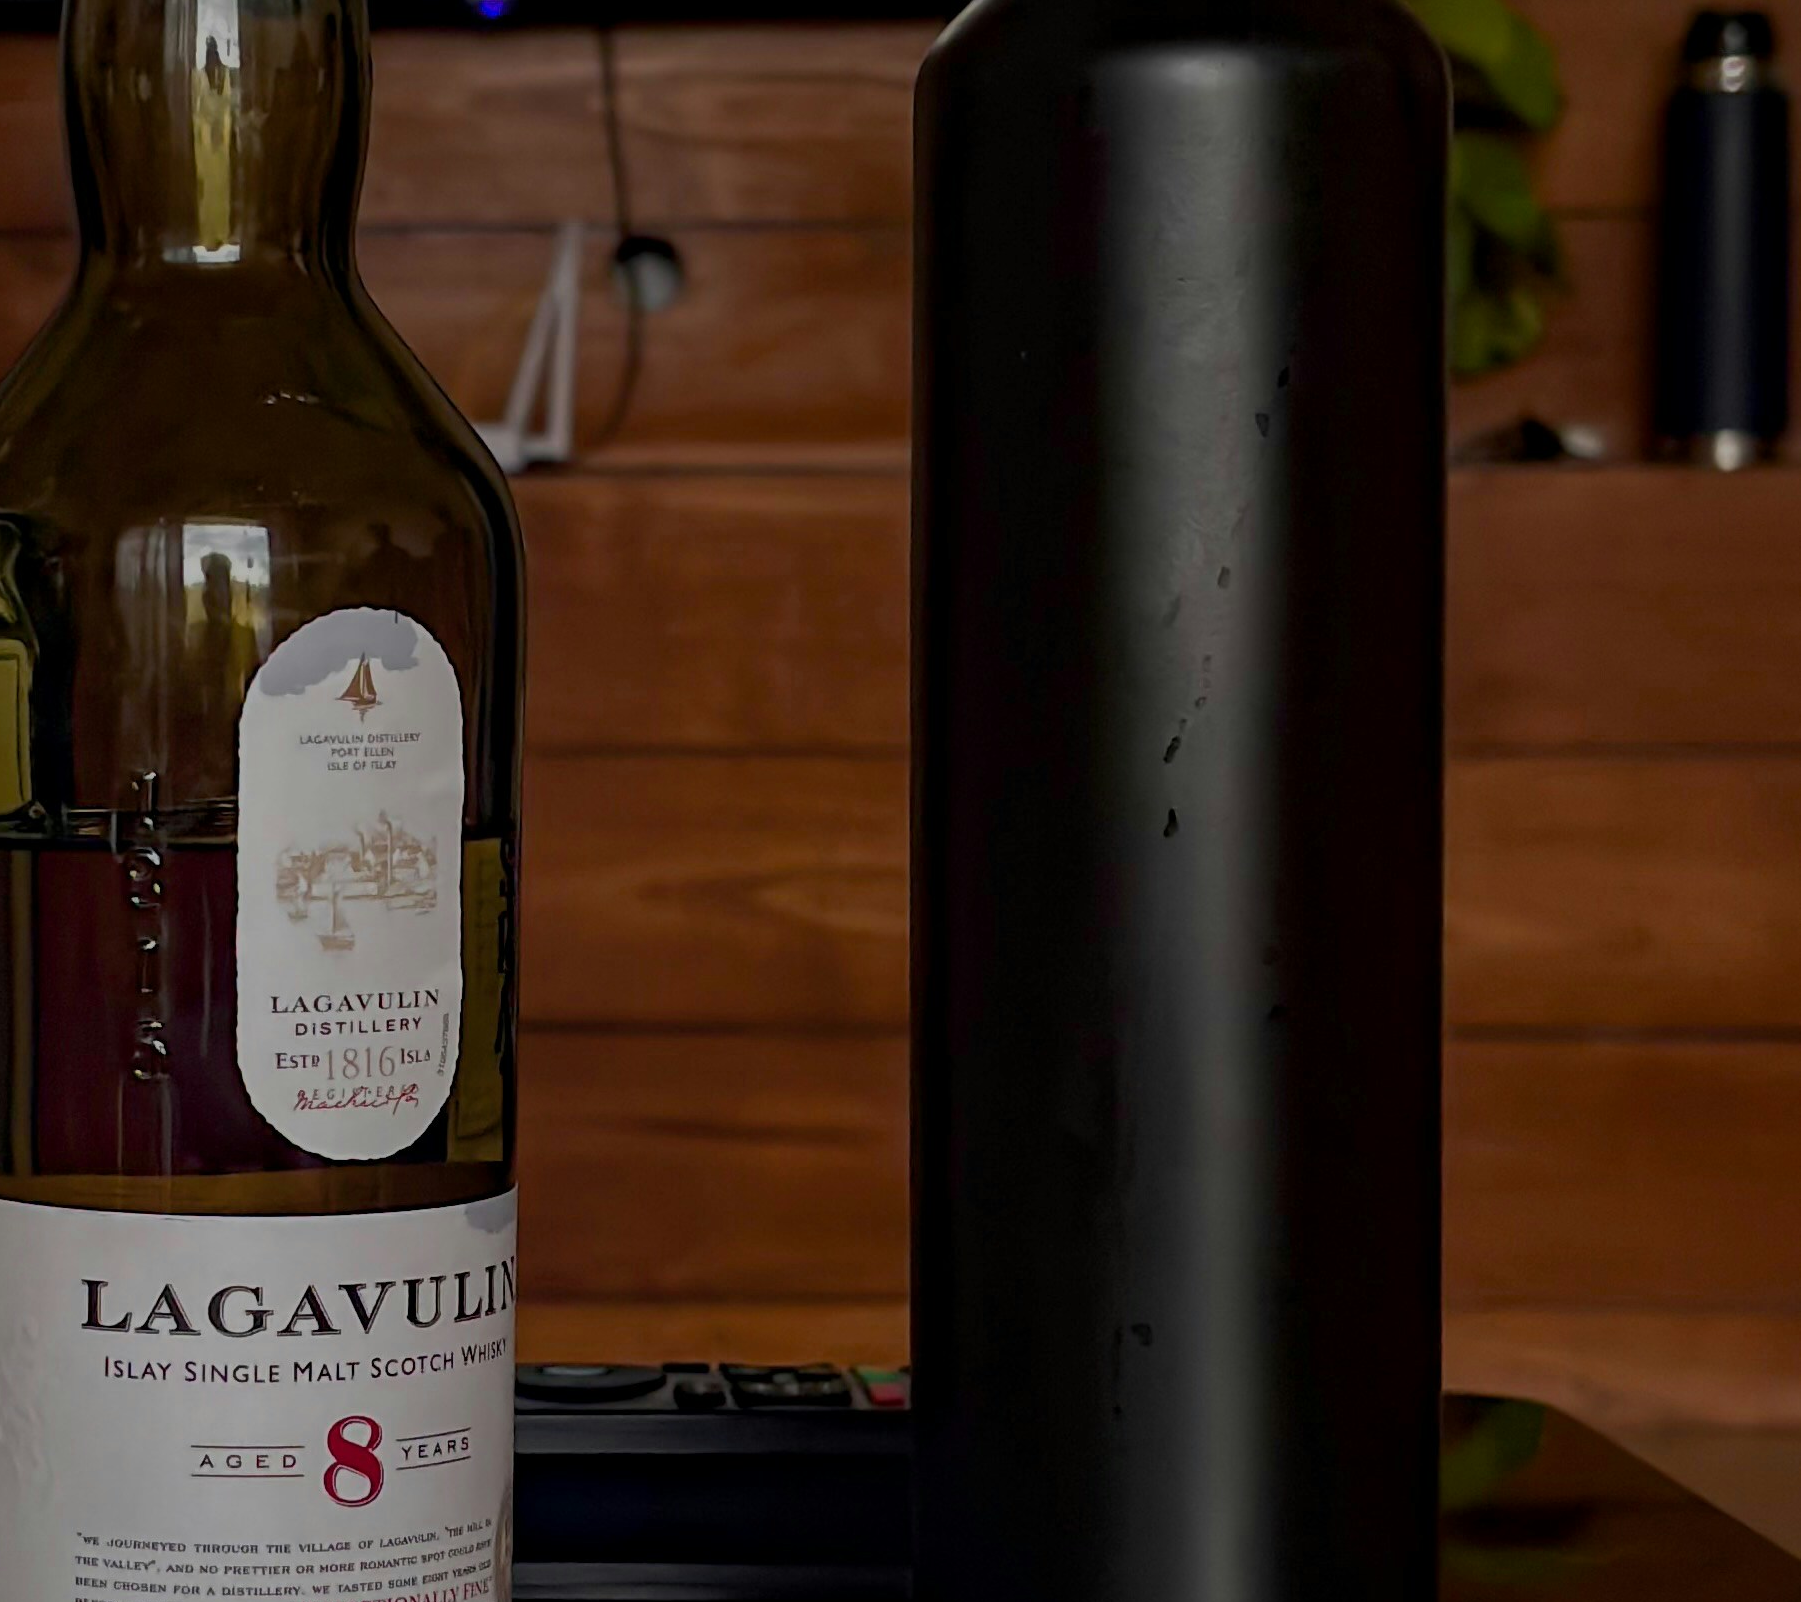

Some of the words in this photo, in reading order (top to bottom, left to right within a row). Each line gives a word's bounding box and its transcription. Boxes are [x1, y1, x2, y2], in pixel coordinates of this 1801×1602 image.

[300, 735, 363, 744] LAGAVULIN
[367, 733, 420, 743] DISTILLERY
[331, 748, 359, 757] PORT
[364, 747, 393, 757] ELLEN
[328, 761, 348, 770] ISLE
[353, 761, 365, 770] OF
[271, 989, 439, 1014] LAGAVULIN
[295, 1016, 422, 1036] DISTILLERY
[327, 1046, 395, 1080] 1816
[80, 1255, 517, 1338] LAGAVULIN
[104, 1355, 172, 1381] ISLAY
[184, 1360, 280, 1384] SINGLE
[294, 1359, 360, 1382] MALT
[370, 1352, 455, 1379] SCOTCH
[461, 1338, 508, 1367] WHISKY
[199, 1452, 298, 1469] AGED
[323, 1414, 384, 1508] 8
[402, 1435, 470, 1461] YEARS
[107, 1538, 187, 1552] JOURNEYED
[194, 1543, 259, 1554] THROUGH
[266, 1544, 292, 1554] THE
[299, 1541, 351, 1553] VILLAGE
[358, 1539, 374, 1550] OF
[75, 1555, 99, 1567] THE
[165, 1564, 194, 1574] AND
[199, 1565, 219, 1575] NO
[223, 1565, 291, 1575] PRETTIER
[296, 1564, 314, 1574] OR
[319, 1562, 355, 1573] MORE
[360, 1555, 418, 1571] ROMANTIC
[421, 1550, 445, 1564] SPOT
[75, 1576, 108, 1589] BEEN
[113, 1580, 167, 1593] CHOSEN
[173, 1585, 200, 1595] FOR
[206, 1586, 216, 1596] A
[312, 1584, 330, 1595] WE
[338, 1580, 383, 1594] TASTED
[388, 1576, 418, 1589] SOME
